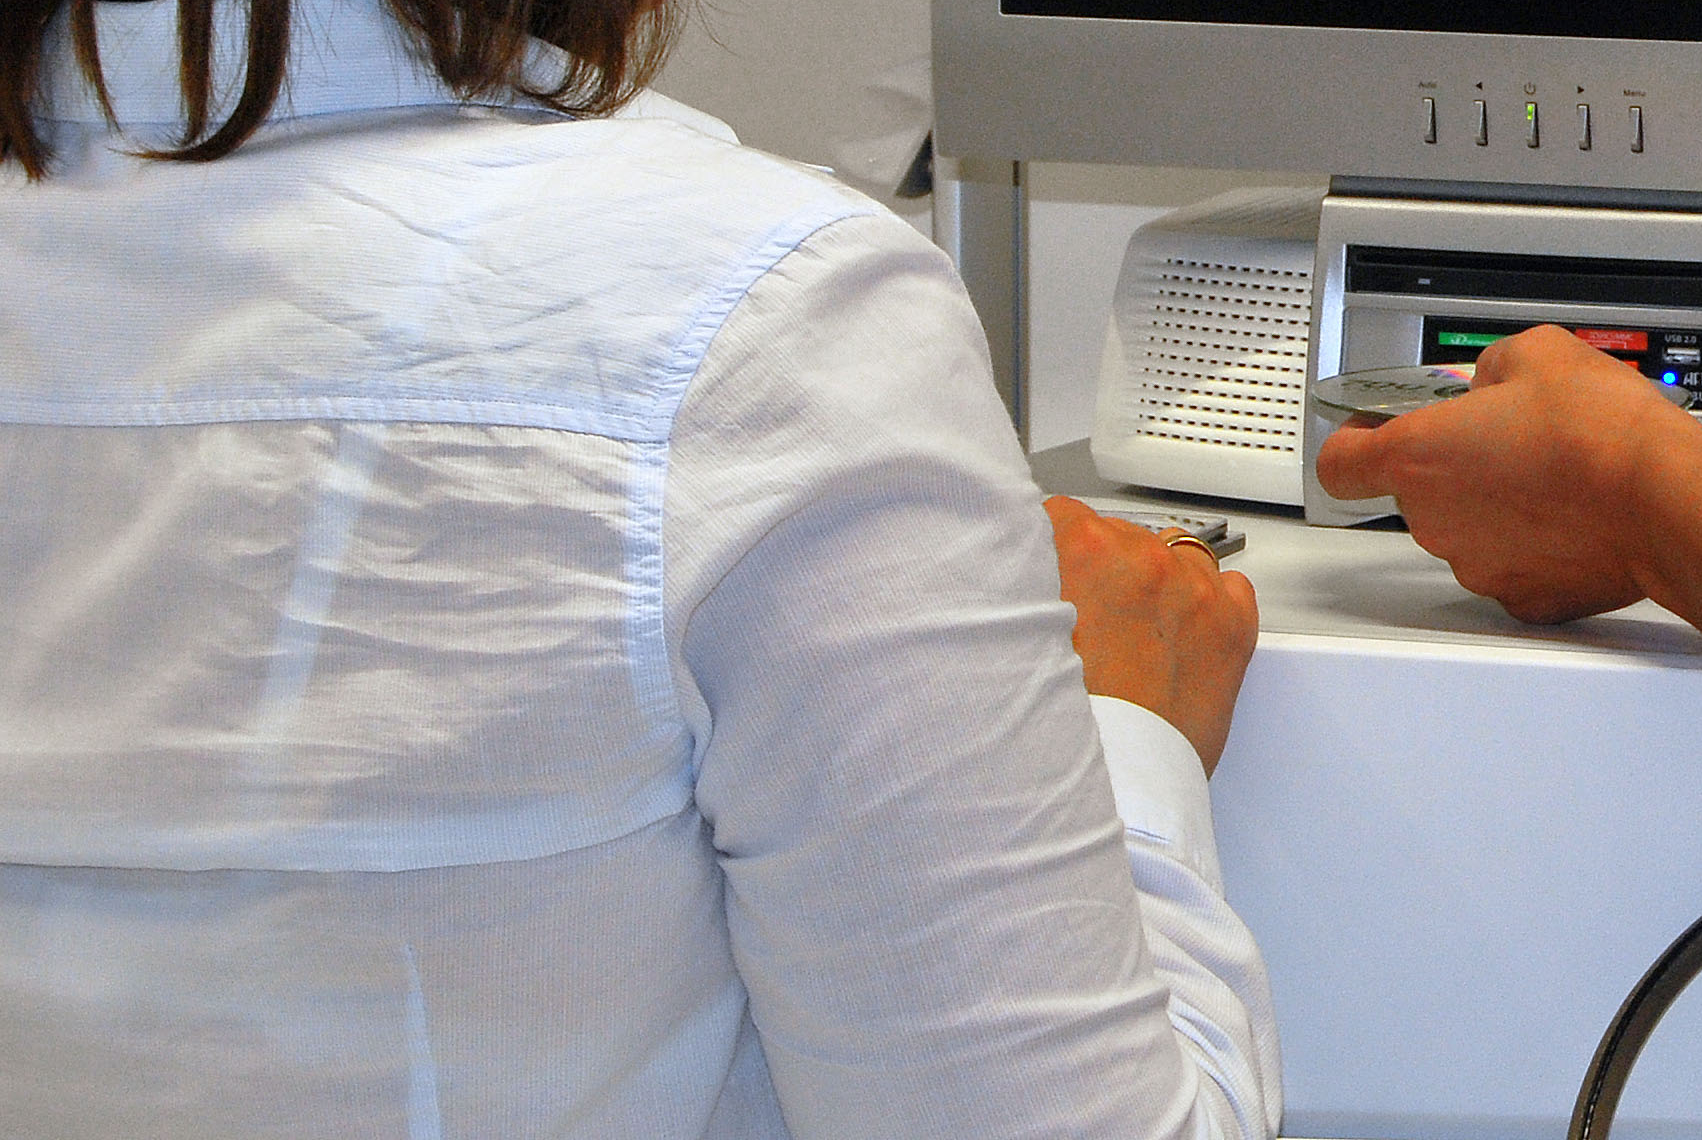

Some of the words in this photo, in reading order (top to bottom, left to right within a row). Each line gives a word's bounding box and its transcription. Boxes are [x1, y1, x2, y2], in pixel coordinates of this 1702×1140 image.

[1623, 88, 1647, 97] Menu
[1664, 334, 1682, 343] USB
[1684, 335, 1697, 344] 2.0
